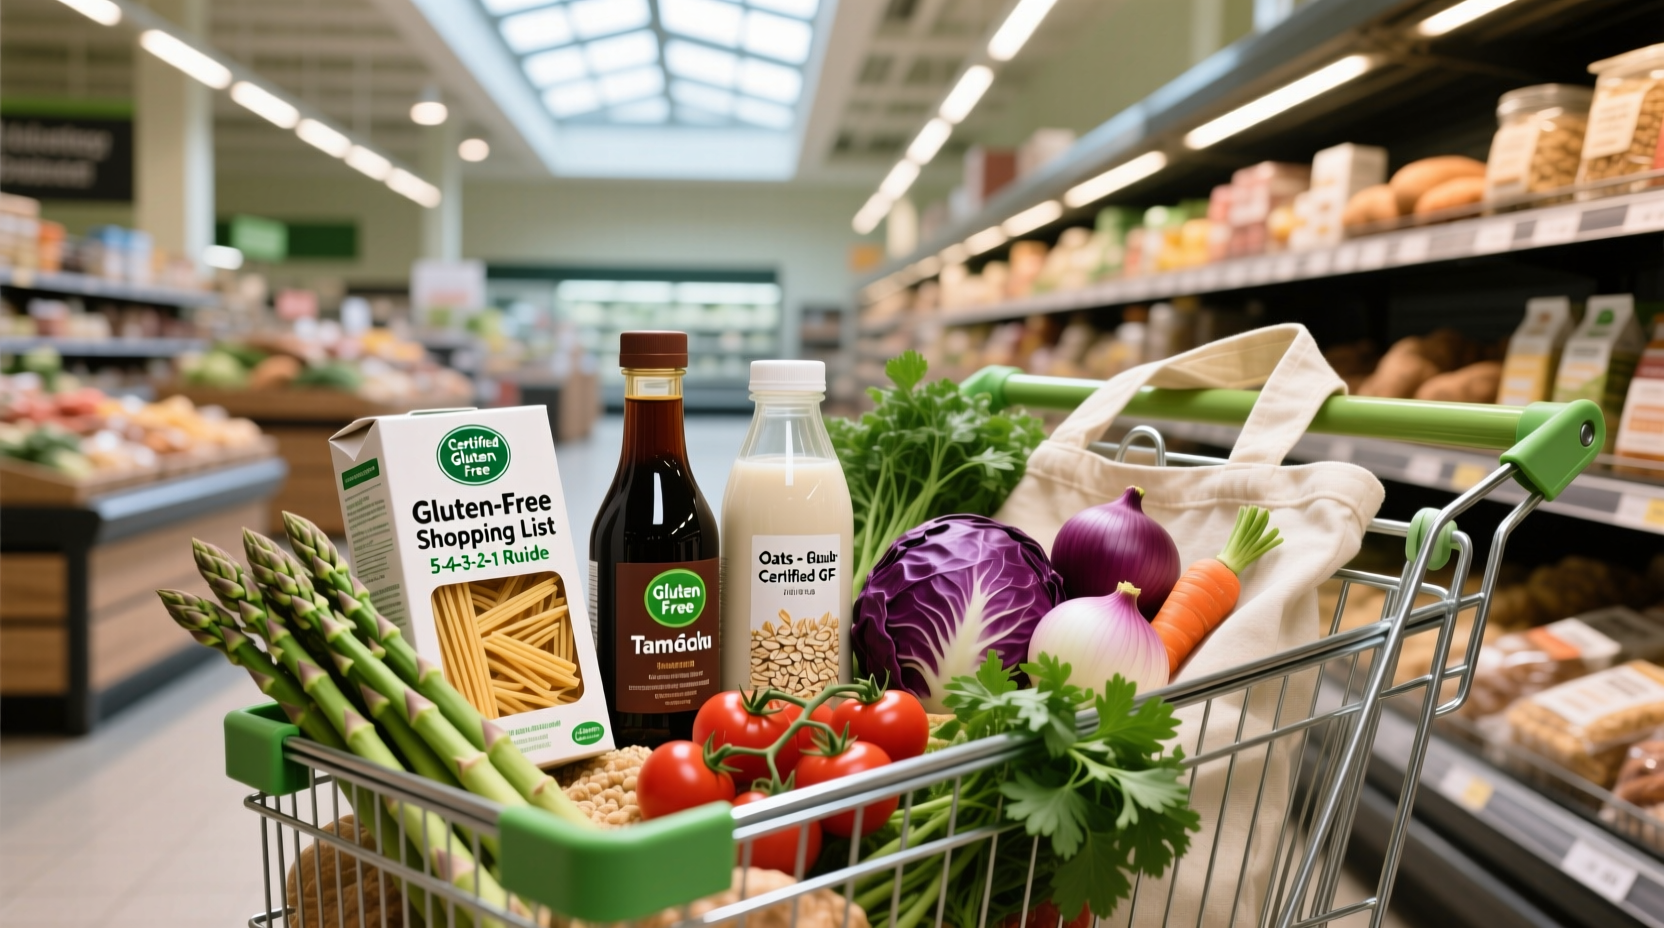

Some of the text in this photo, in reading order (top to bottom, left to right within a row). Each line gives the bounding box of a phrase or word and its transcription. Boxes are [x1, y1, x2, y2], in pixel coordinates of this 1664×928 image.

[412, 492, 552, 524] Gluten-Free
[416, 516, 556, 550] Shopping List
[430, 544, 549, 574] 5-4-3-2-1 Ruide
[758, 550, 794, 565] Oats
[818, 568, 836, 582] GF
[652, 583, 701, 600] Gluten
[661, 600, 694, 615] Free
